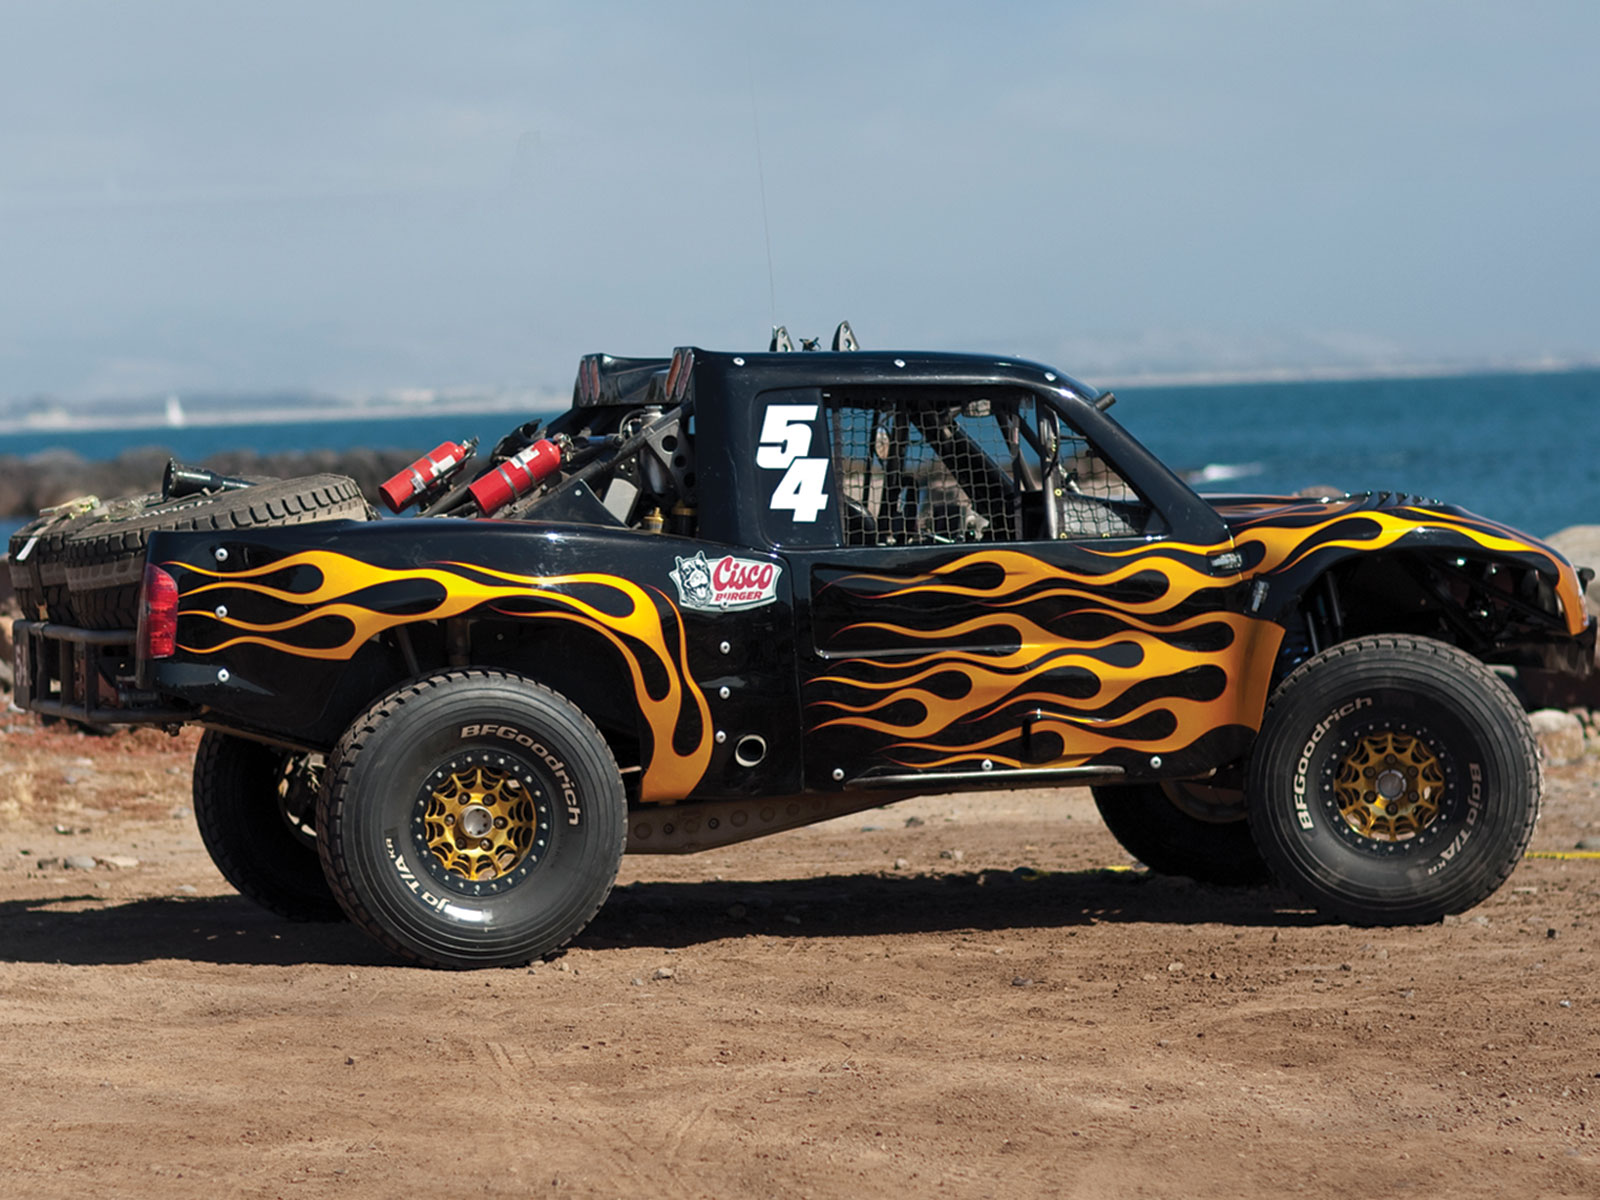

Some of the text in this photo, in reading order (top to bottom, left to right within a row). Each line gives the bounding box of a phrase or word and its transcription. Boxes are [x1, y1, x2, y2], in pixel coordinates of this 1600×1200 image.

[712, 556, 773, 591] Cisco
[460, 724, 581, 826] BFGoodrich
[1293, 697, 1373, 830] BFGoodrich
[1467, 762, 1483, 826] Baja
[1440, 829, 1472, 860] T/A
[394, 854, 421, 894] T/A
